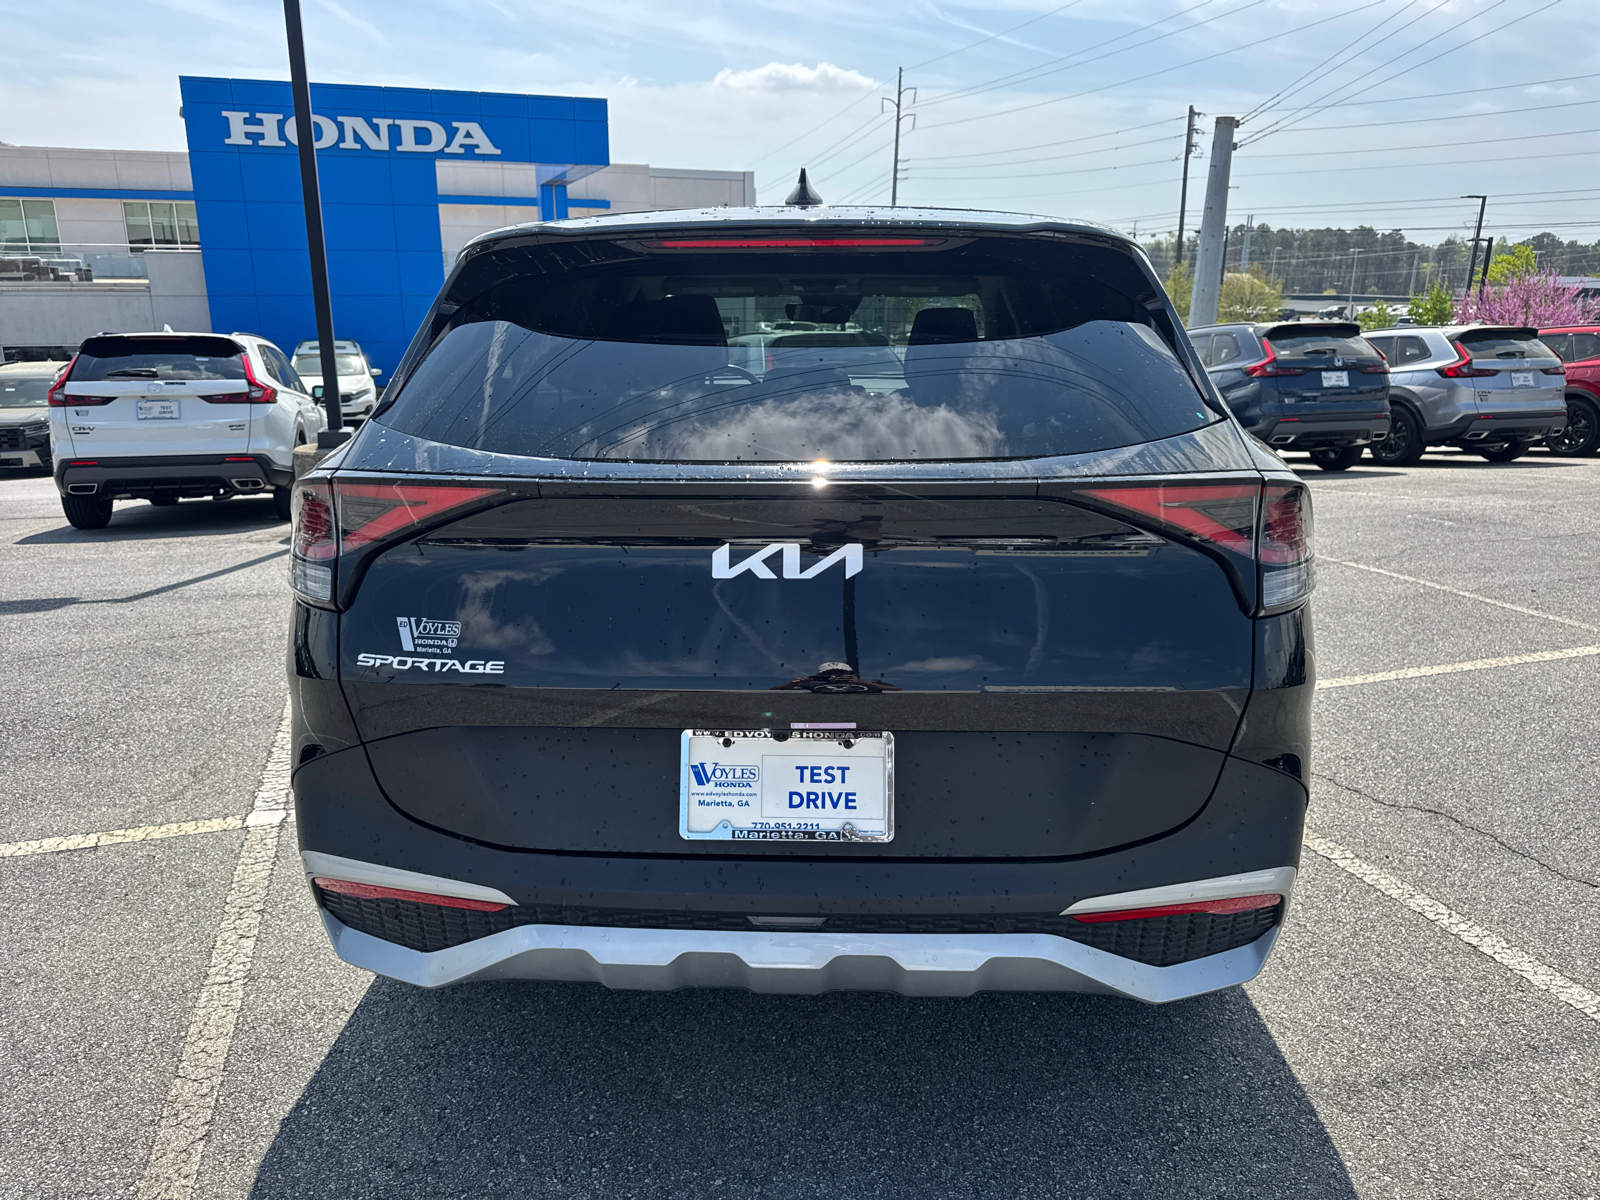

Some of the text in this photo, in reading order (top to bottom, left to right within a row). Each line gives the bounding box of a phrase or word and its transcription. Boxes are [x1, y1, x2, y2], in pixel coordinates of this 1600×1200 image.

[221, 110, 501, 155] HONDA
[712, 543, 863, 579] KIA
[414, 638, 448, 646] HONDA
[416, 646, 442, 655] Marietta,
[356, 653, 505, 674] SPORTAGE
[795, 765, 850, 784] TEST
[698, 799, 735, 808] Marietta,
[788, 791, 857, 810] DRIVE
[751, 822, 820, 830] 770-951-2211
[734, 830, 839, 840] Marietta, GA
